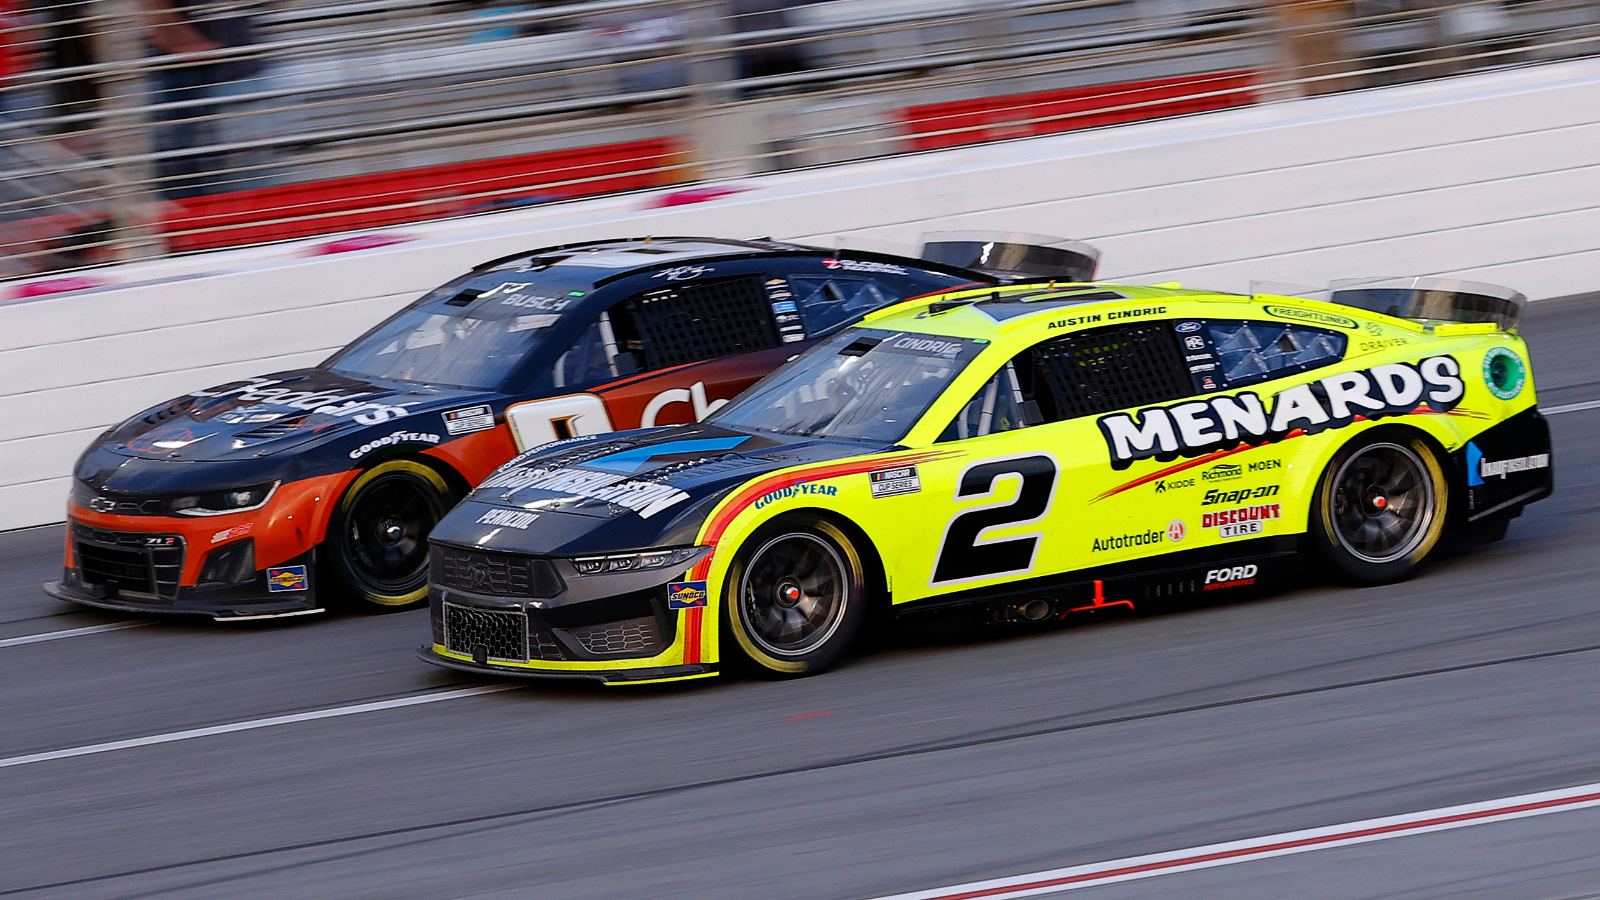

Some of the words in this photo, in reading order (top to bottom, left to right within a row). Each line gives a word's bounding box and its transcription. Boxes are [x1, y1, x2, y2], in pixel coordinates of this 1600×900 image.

[501, 293, 572, 312] BUSCH
[1047, 313, 1102, 330] AUSTIN
[1107, 306, 1168, 321] CINDRIC
[1273, 306, 1351, 326] FREIGHTLINER
[1099, 354, 1464, 466] MENARDS
[497, 451, 526, 473] FORD
[525, 434, 598, 457] PERFORMANCE
[1202, 465, 1242, 481] Richmond
[1248, 459, 1282, 473] MOEN
[1167, 479, 1196, 490] KIDDE
[1201, 485, 1280, 506] Snap-on
[475, 508, 541, 530] PENNZOIL
[927, 450, 1061, 589] 2
[1201, 503, 1281, 529] DISCOUNT
[1224, 523, 1258, 536] TIRE
[1092, 530, 1165, 553] Autotrader
[1204, 564, 1258, 585] FORD
[671, 590, 706, 600] SUNOCO
